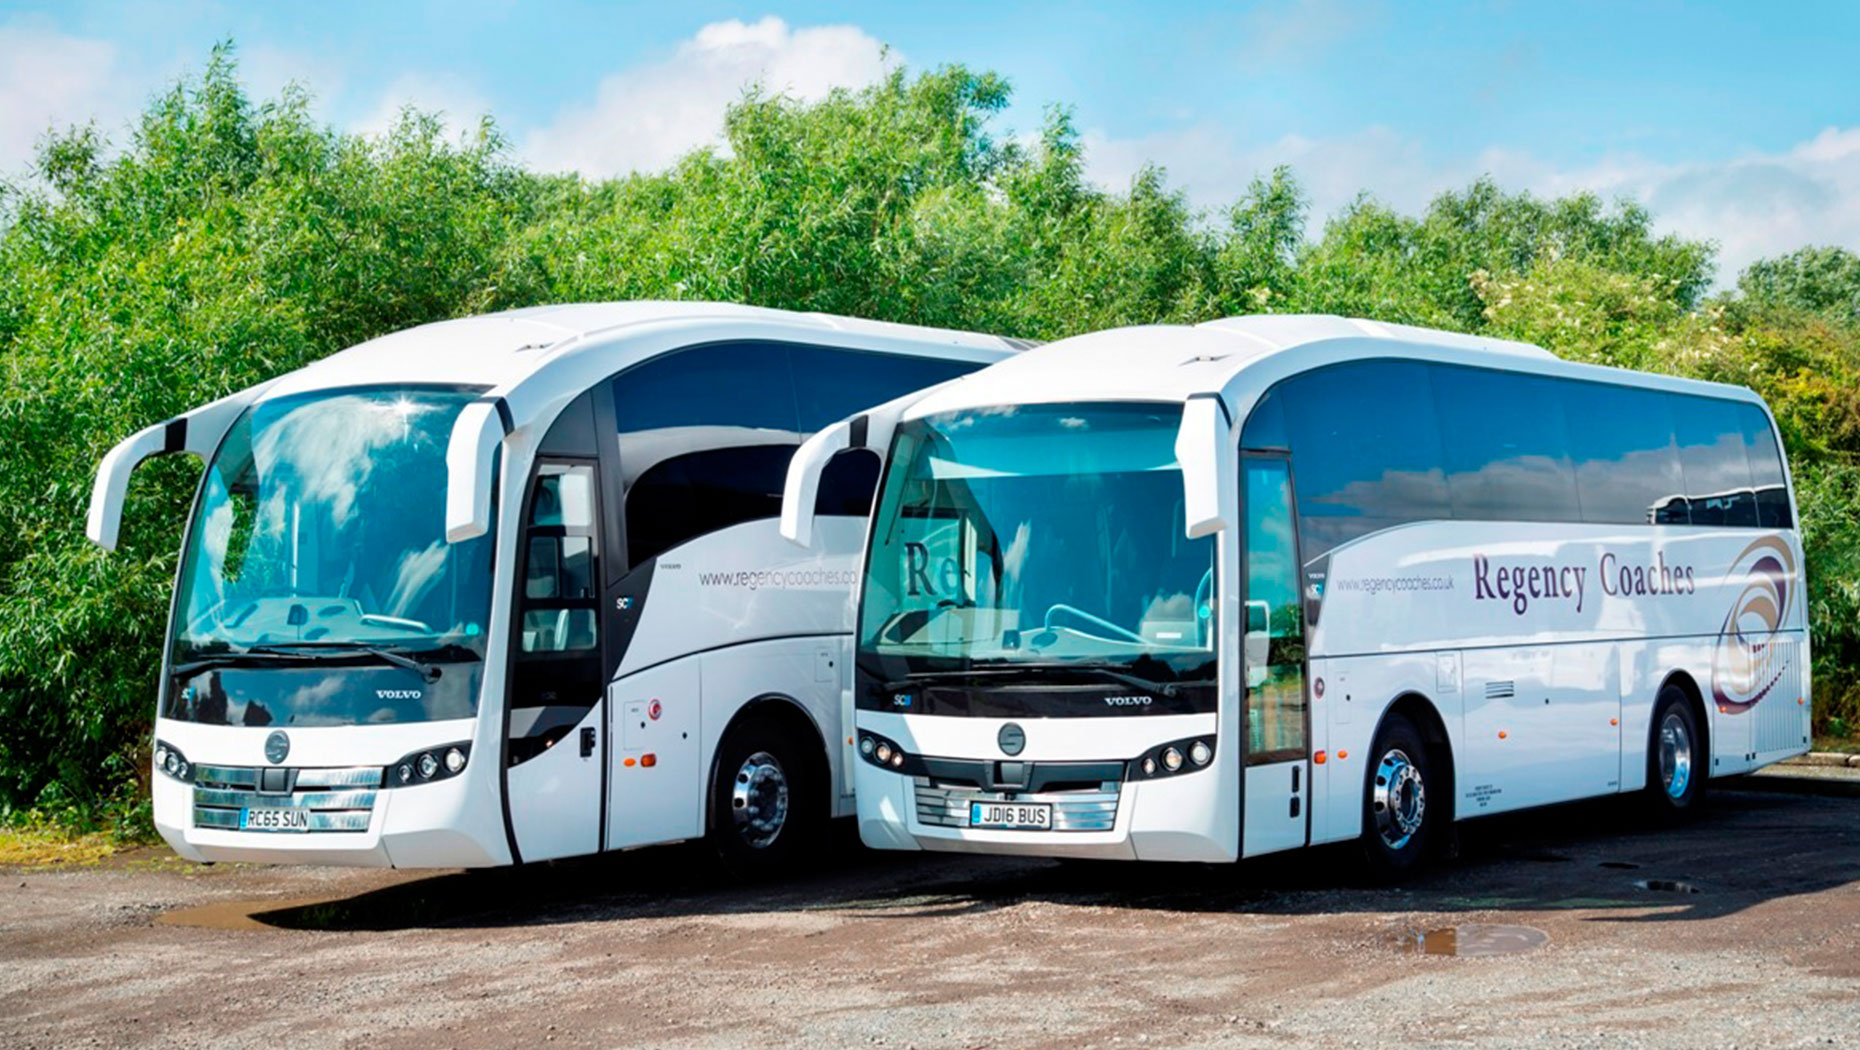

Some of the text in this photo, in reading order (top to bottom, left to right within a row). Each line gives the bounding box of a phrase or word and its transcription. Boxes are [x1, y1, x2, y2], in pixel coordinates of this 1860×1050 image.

[699, 568, 857, 591] www.regencycoaches.co
[1336, 574, 1455, 596] www.regencycoaches.co.uk
[1473, 550, 1696, 616] Regency Coaches
[376, 689, 422, 699] VOLVO
[1104, 696, 1152, 706] VOLVO
[247, 810, 309, 827] RC65 SUN
[983, 807, 1046, 824] JD16 BUS
